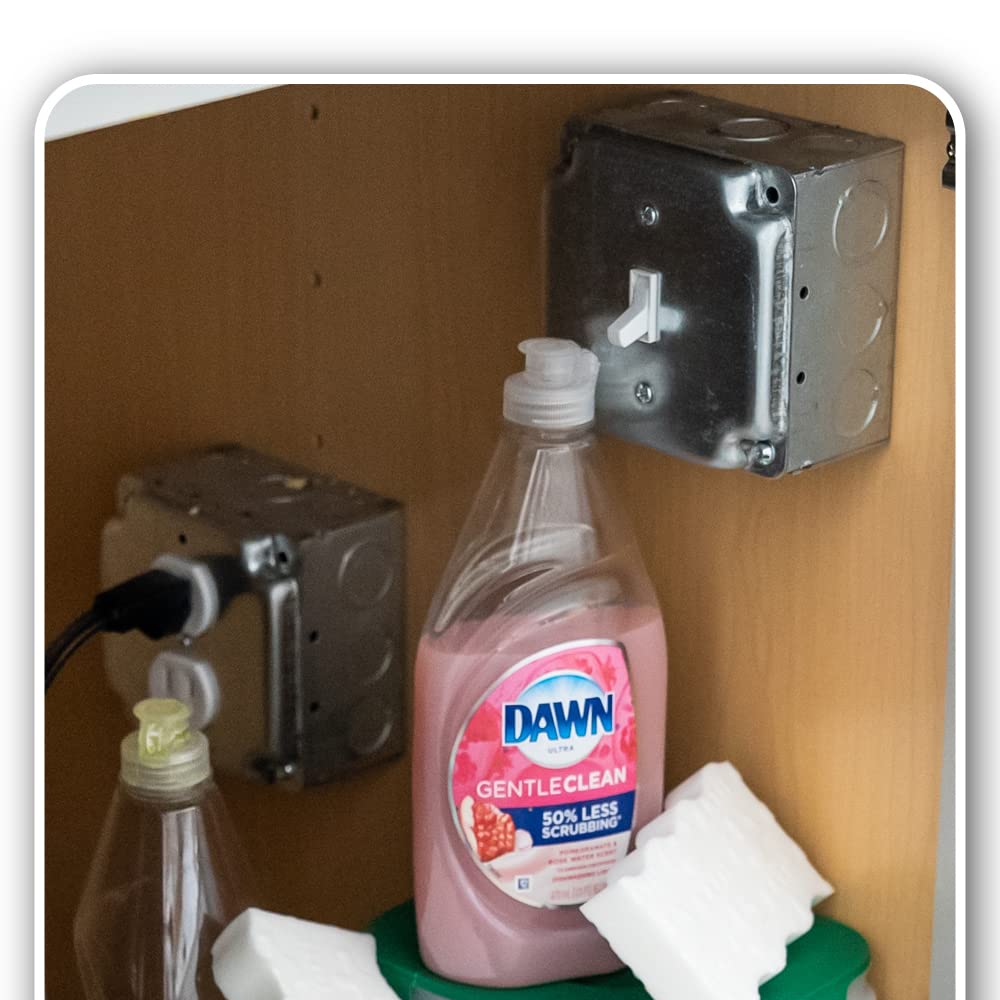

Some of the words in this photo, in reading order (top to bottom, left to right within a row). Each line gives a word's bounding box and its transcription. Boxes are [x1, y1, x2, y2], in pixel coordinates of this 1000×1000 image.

[504, 694, 614, 744] DAWN
[542, 809, 577, 825] 50%
[581, 801, 619, 821] LESS
